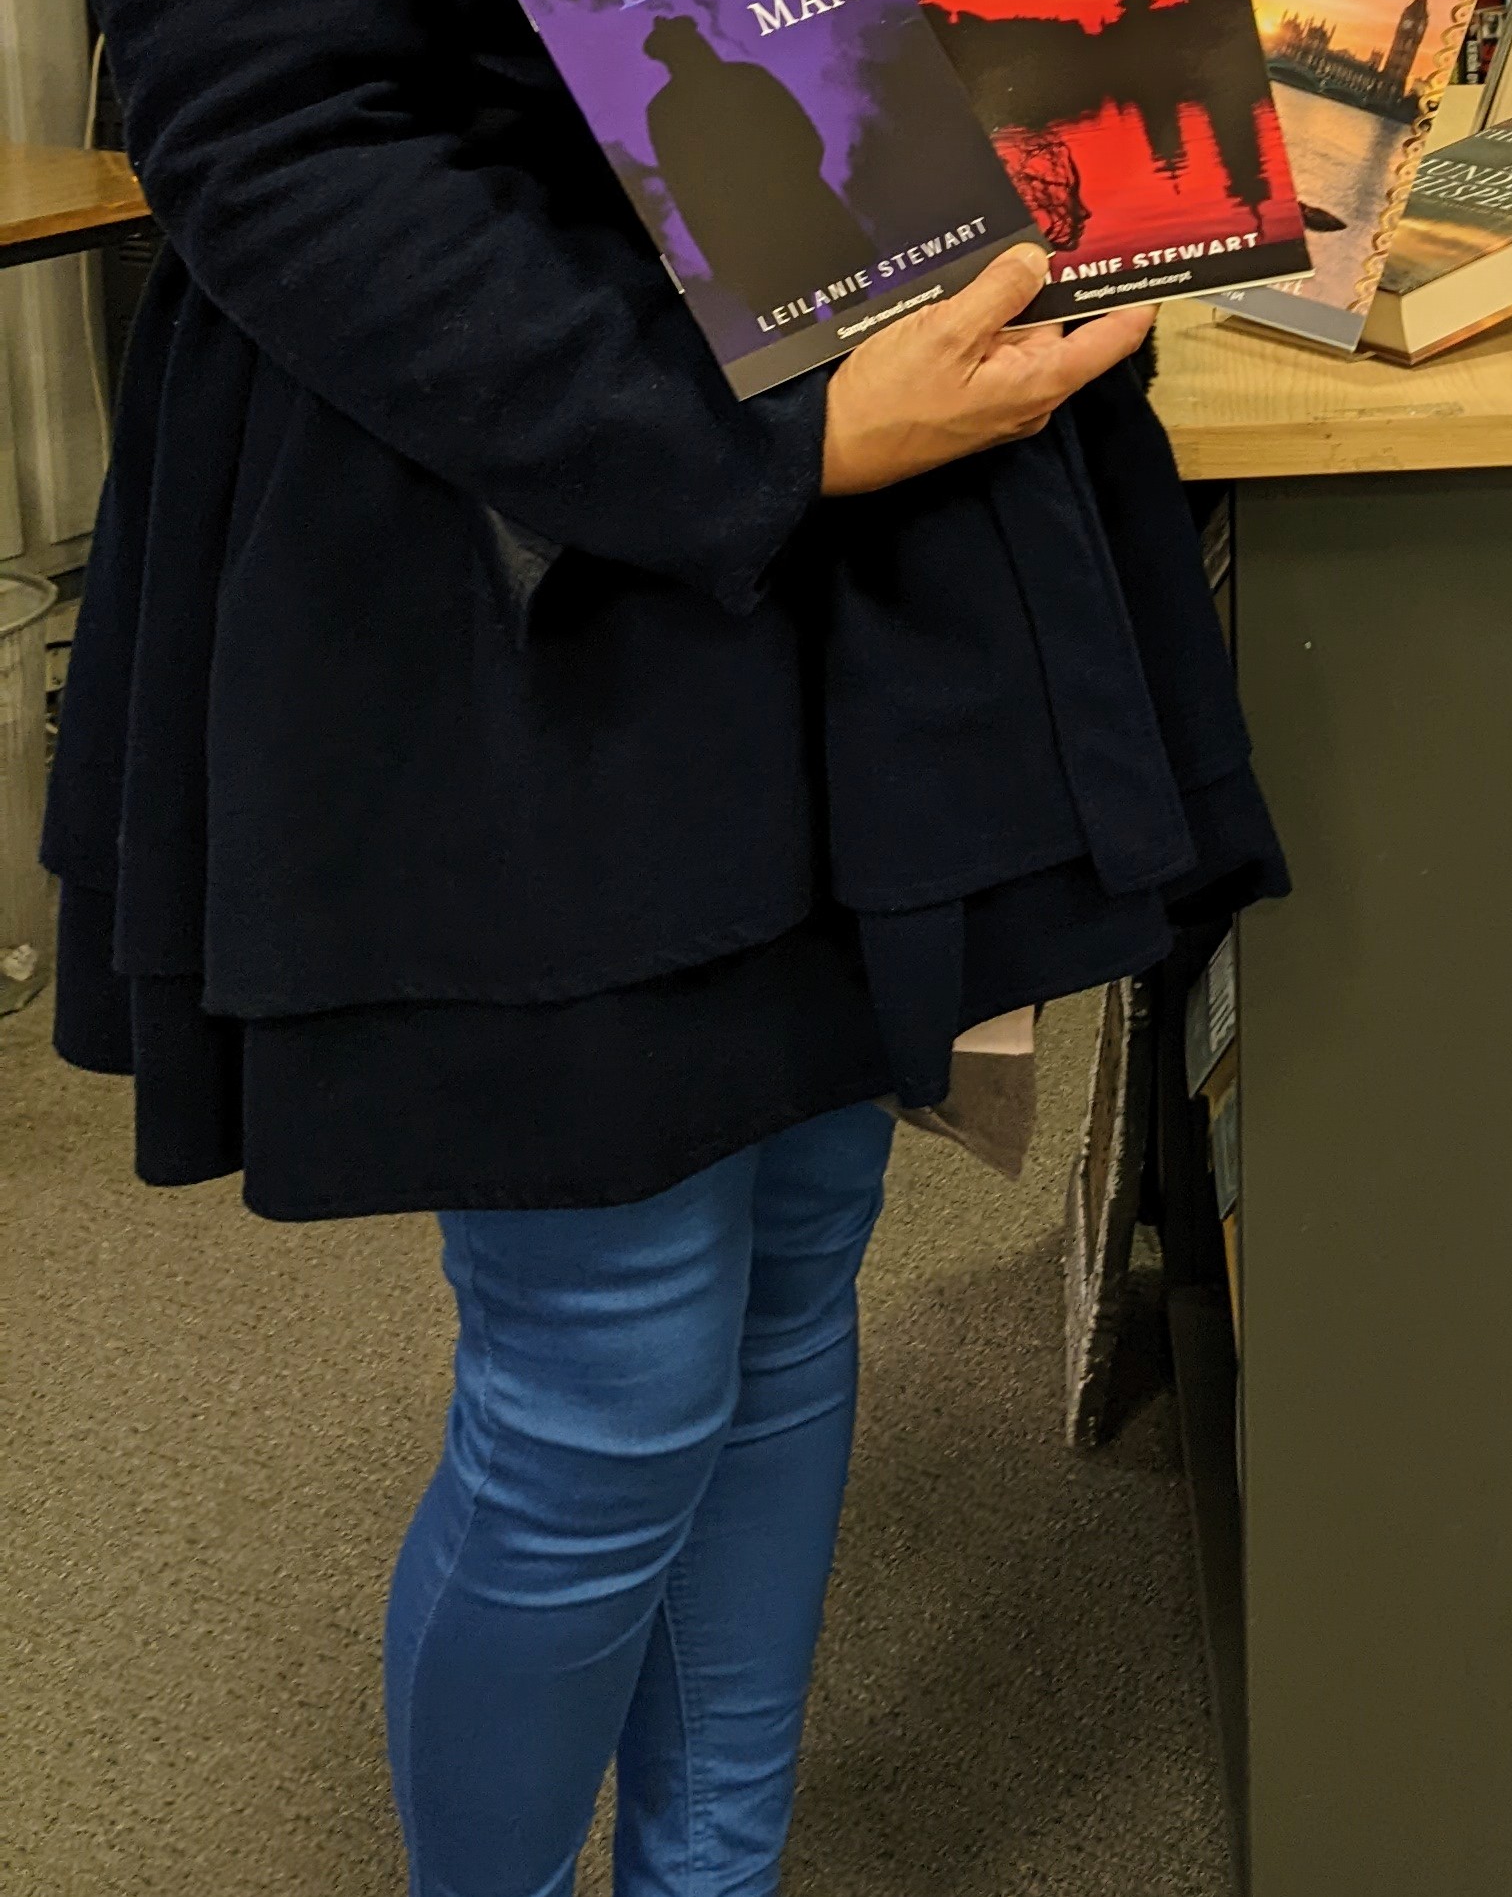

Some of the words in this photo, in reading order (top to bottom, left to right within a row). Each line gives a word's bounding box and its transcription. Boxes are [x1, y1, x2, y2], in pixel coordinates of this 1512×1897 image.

[1132, 232, 1258, 269] STEWART
[756, 270, 873, 333] LEILANIE
[877, 217, 988, 278] STEWART
[1074, 285, 1116, 302] Sample
[1117, 277, 1149, 294] novel
[1149, 270, 1193, 287] excerpt
